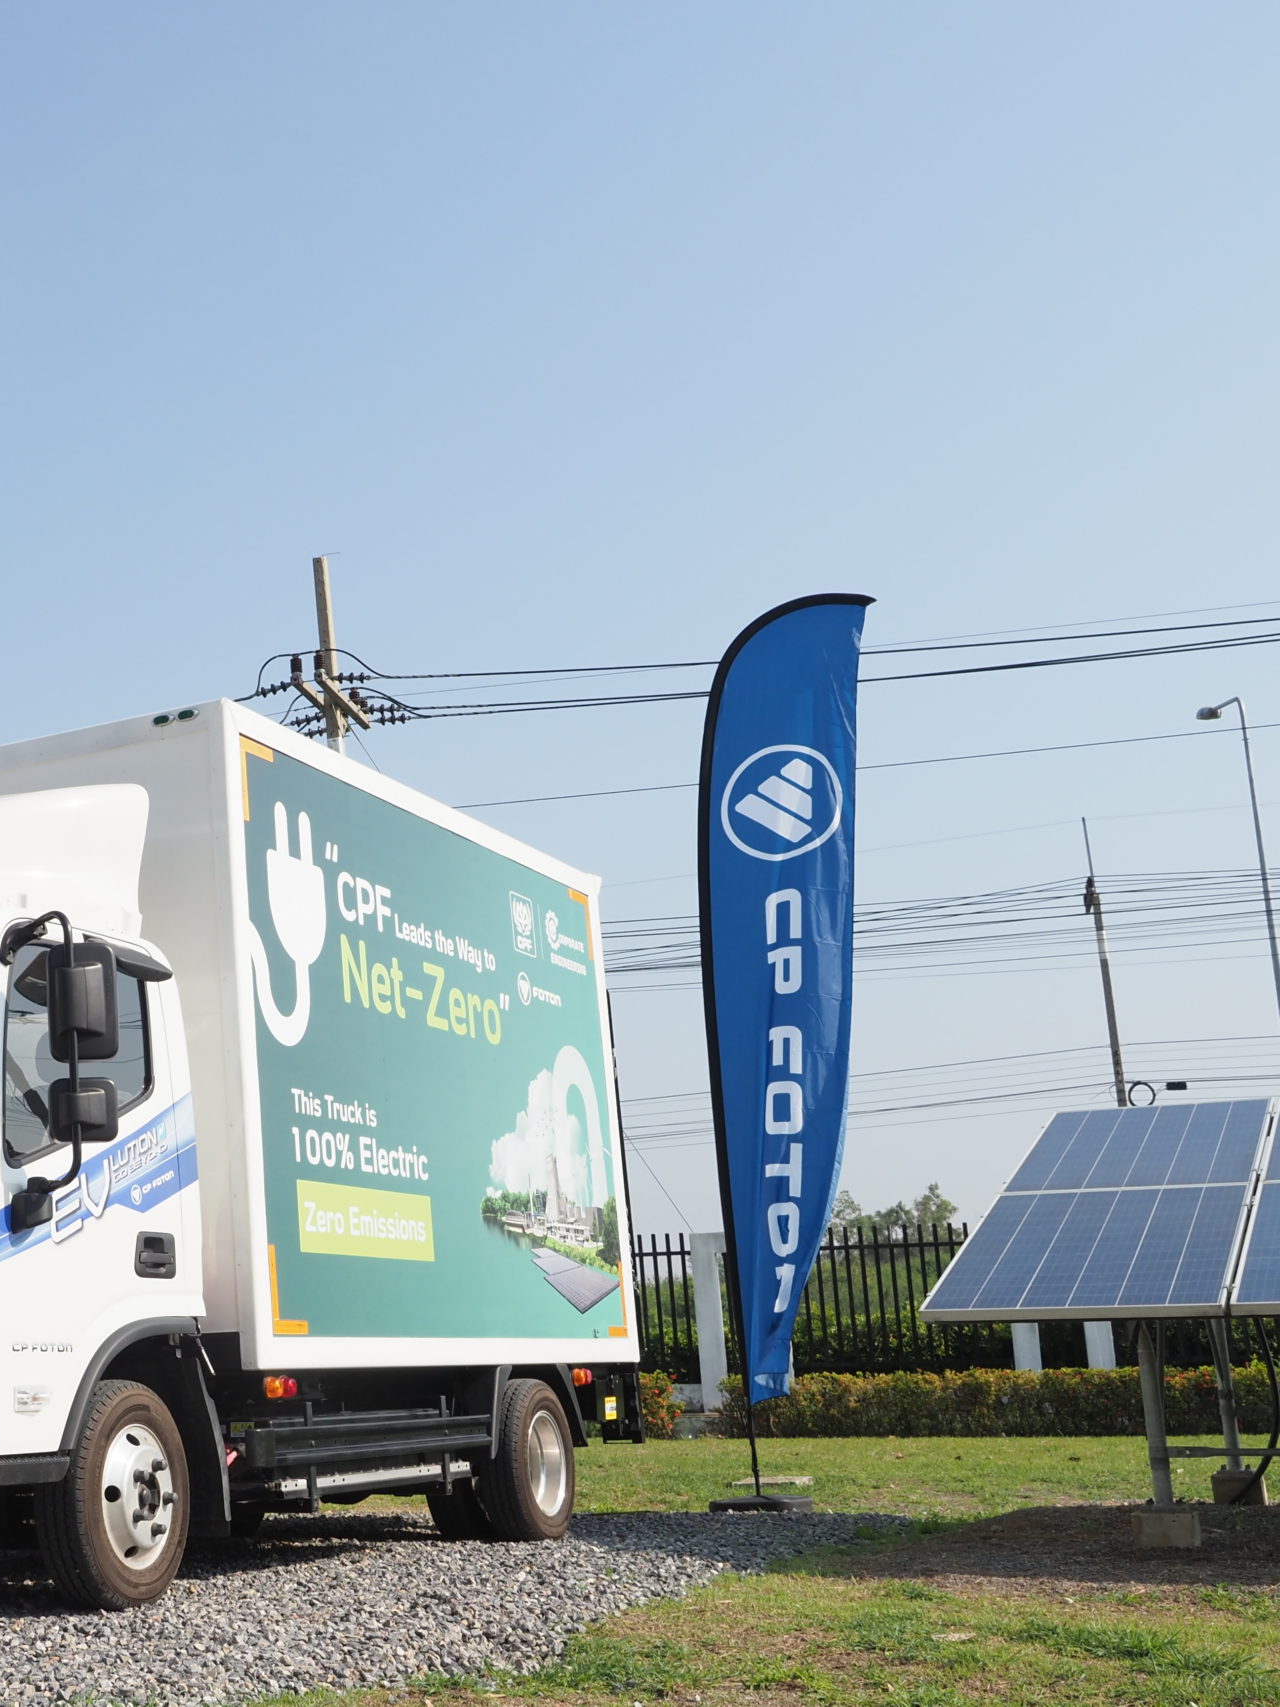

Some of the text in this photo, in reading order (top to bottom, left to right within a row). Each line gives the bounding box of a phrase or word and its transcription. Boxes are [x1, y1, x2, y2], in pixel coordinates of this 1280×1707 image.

[394, 913, 433, 949] Leads
[434, 930, 455, 957] the
[456, 936, 483, 974] Way
[484, 948, 496, 971] to
[765, 888, 803, 996] CP
[532, 986, 562, 1007] FOTON
[291, 1087, 377, 1128] This Truck is
[292, 1126, 429, 1181] 100% Electric
[303, 1201, 426, 1242] Zero Emissions
[12, 1343, 73, 1353] CP FOTON
